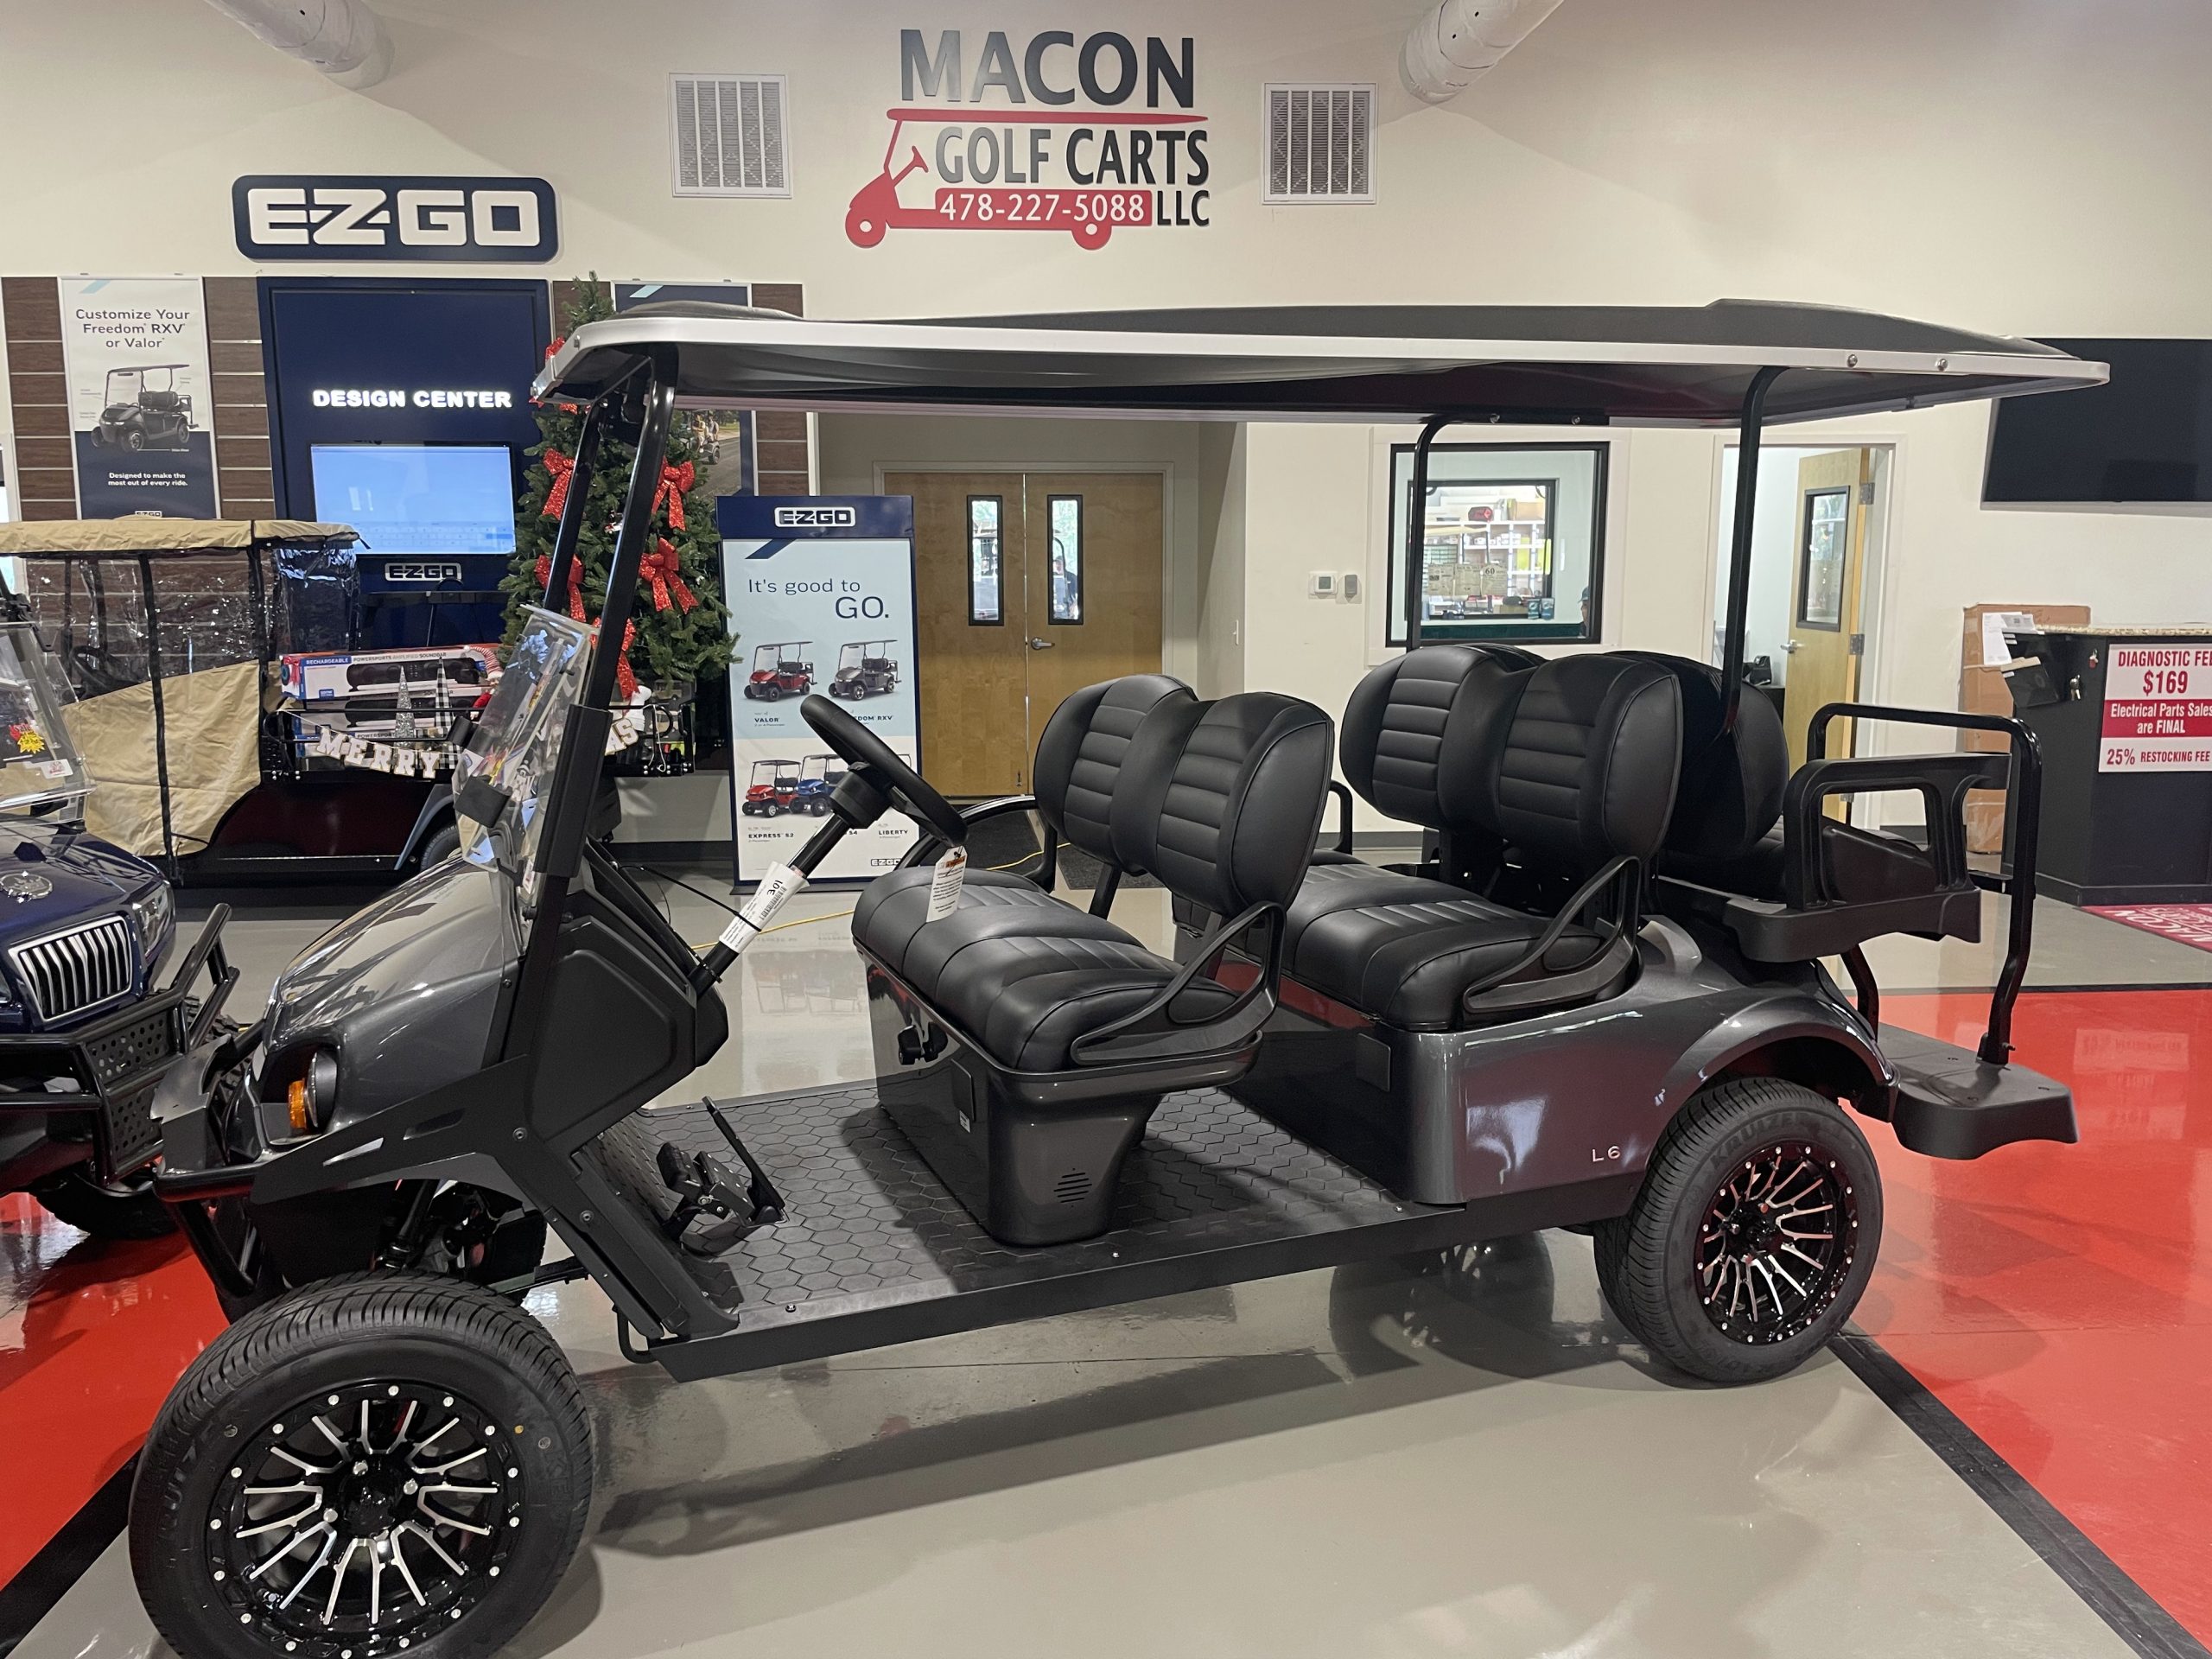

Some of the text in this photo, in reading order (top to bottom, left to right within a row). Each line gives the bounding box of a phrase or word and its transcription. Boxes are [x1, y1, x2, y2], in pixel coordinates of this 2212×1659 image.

[900, 29, 1194, 108] MACON
[936, 126, 1210, 186] GOLF CARTS
[939, 189, 1210, 226] 478-227-5088 LLC
[247, 188, 540, 246] EZGO
[76, 308, 189, 320] Customize Your
[83, 323, 183, 334] Freedom RXV
[105, 338, 162, 348] or Valor
[313, 390, 512, 408] DESIGN CENTER
[779, 510, 851, 524] EZGO
[389, 565, 458, 578] EZGO
[748, 578, 861, 596] It's good to
[835, 596, 889, 619] GO.
[306, 657, 349, 665] RECHARGEABLE
[353, 654, 391, 663] POWERSPORTS
[2118, 651, 2190, 667] DIAGNOSTIC
[2143, 670, 2188, 696] $169
[2111, 702, 2212, 717] Electrical Parts Sales
[2137, 720, 2186, 734] are FINAL
[316, 728, 441, 779] MERRY
[2107, 748, 2210, 766] 25% RESTOCKING FEE
